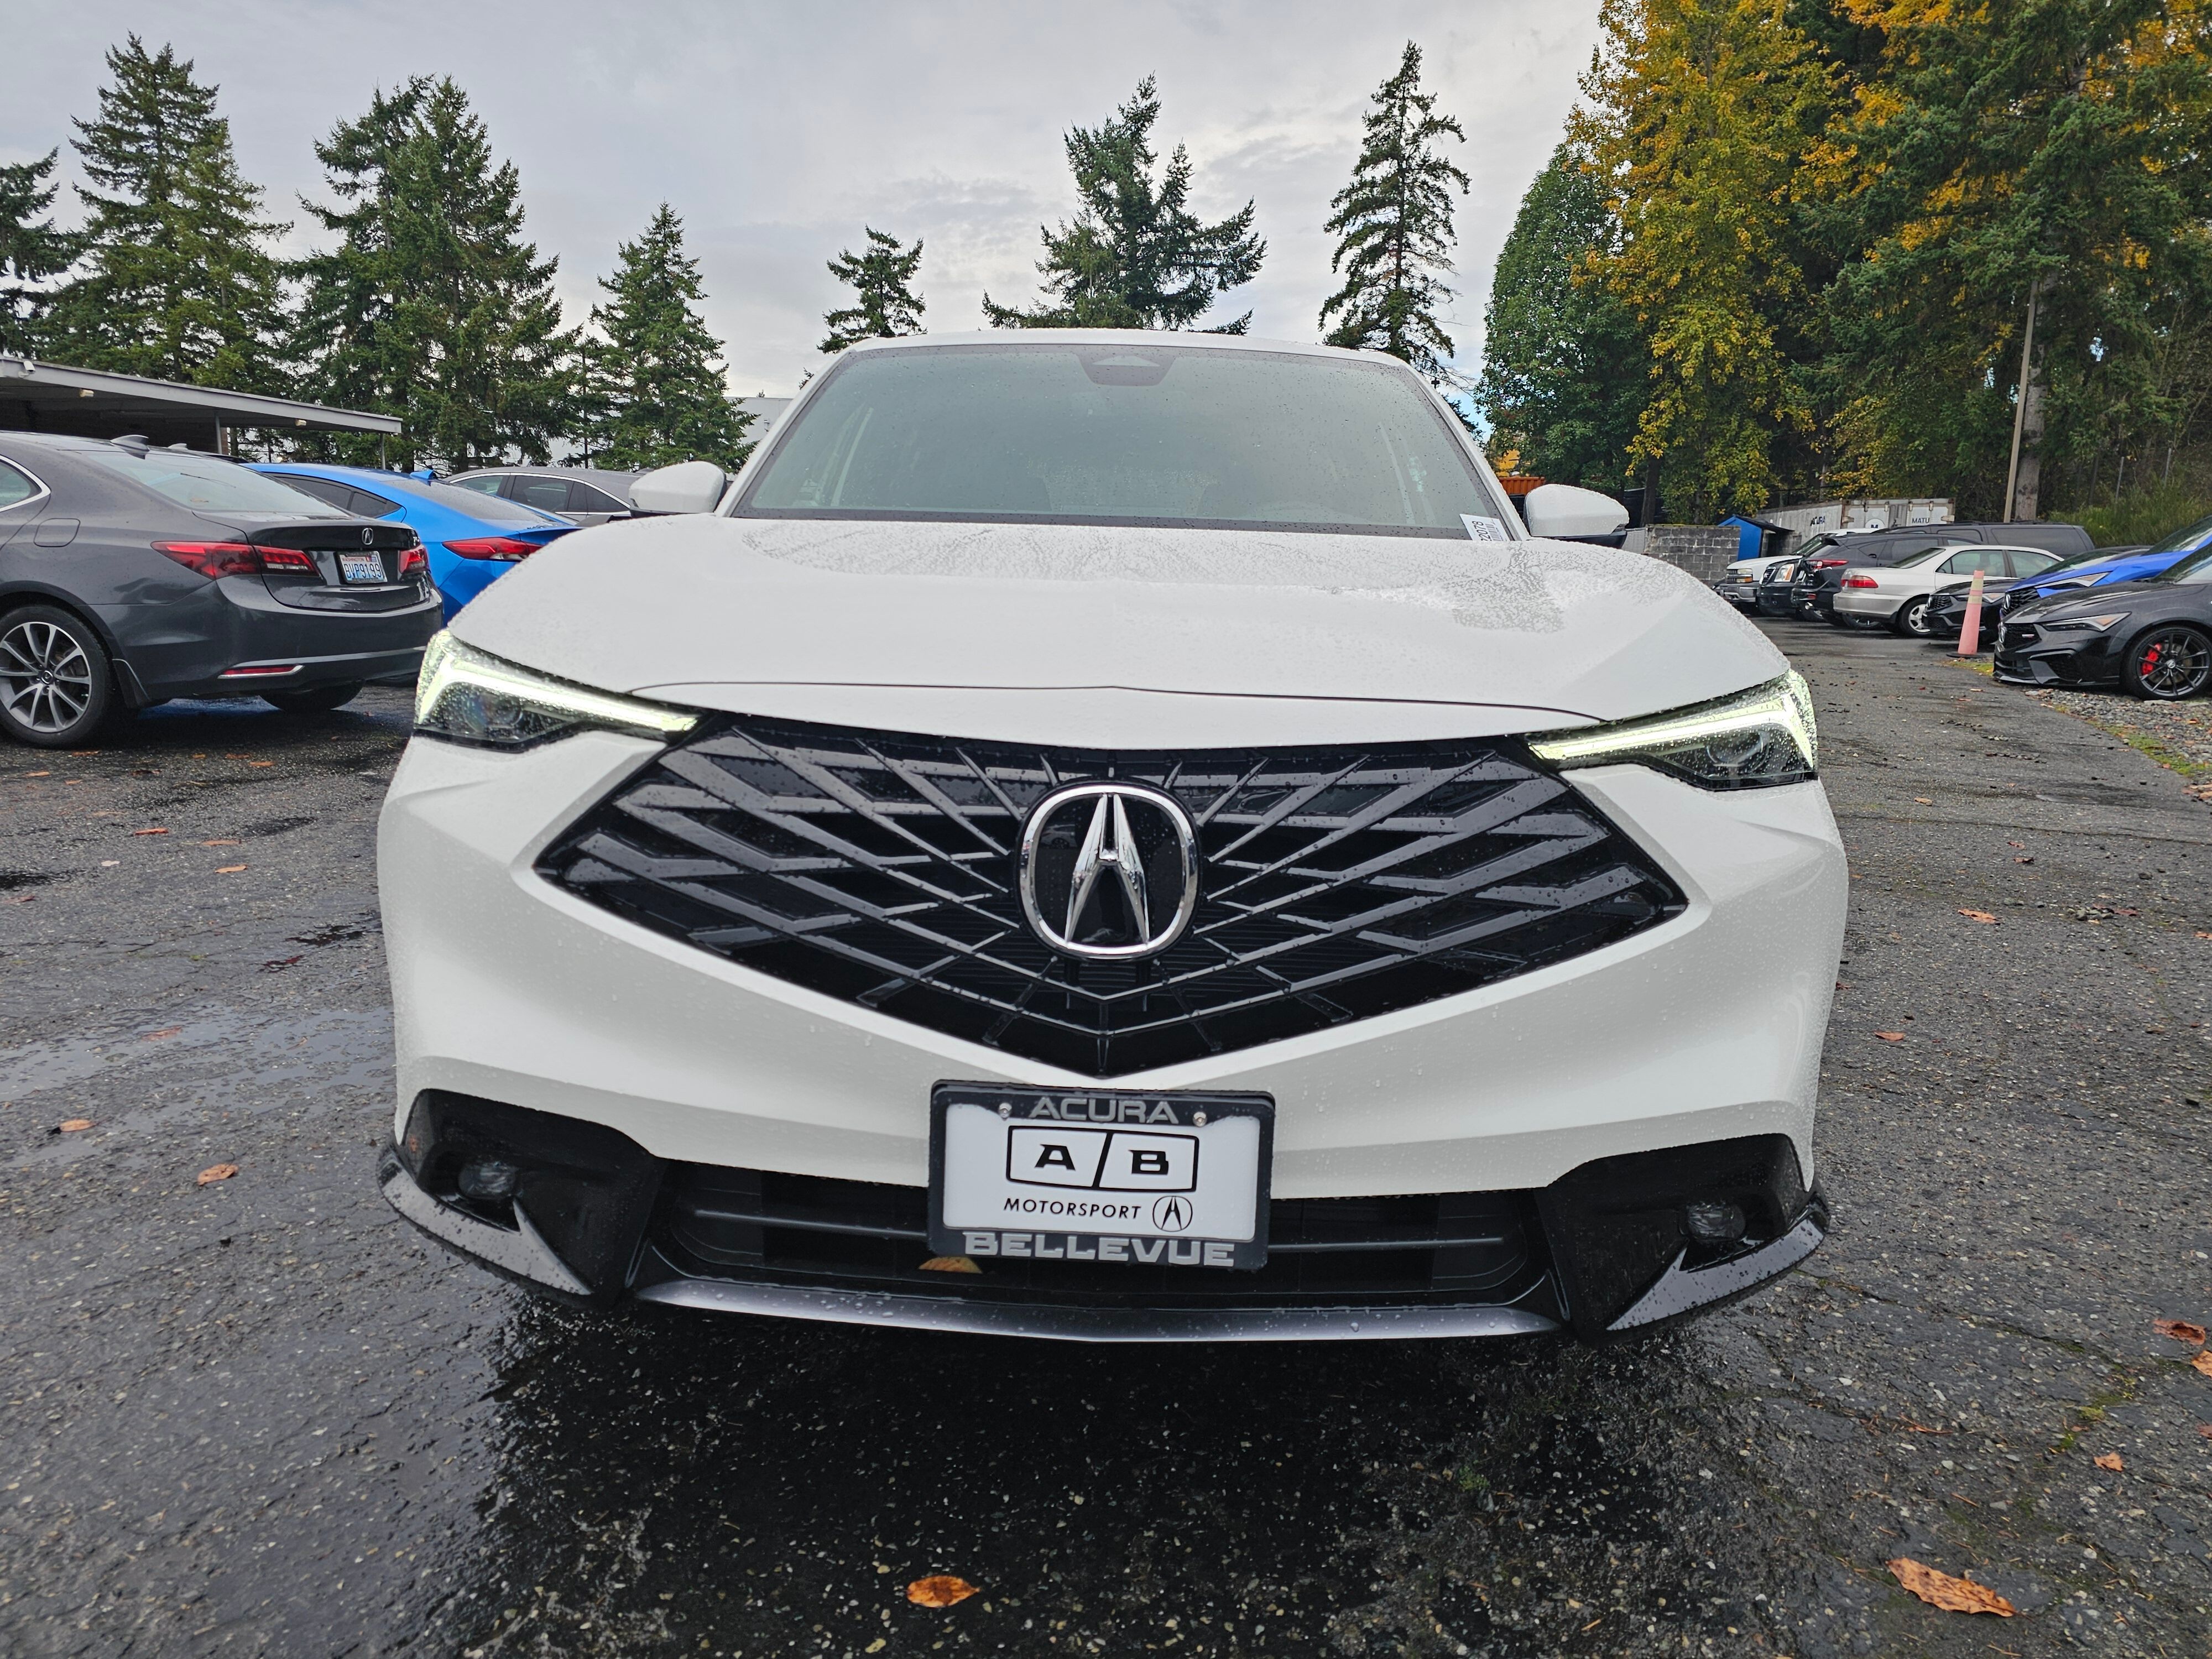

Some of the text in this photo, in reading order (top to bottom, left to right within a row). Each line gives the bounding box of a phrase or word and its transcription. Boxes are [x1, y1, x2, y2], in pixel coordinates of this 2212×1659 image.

[343, 564, 382, 579] BVP9199
[1028, 1097, 1179, 1124] ACURA
[1034, 1144, 1169, 1175] A B
[1003, 1198, 1142, 1219] MOTORSPORT
[962, 1231, 1235, 1267] BELLEVUE
